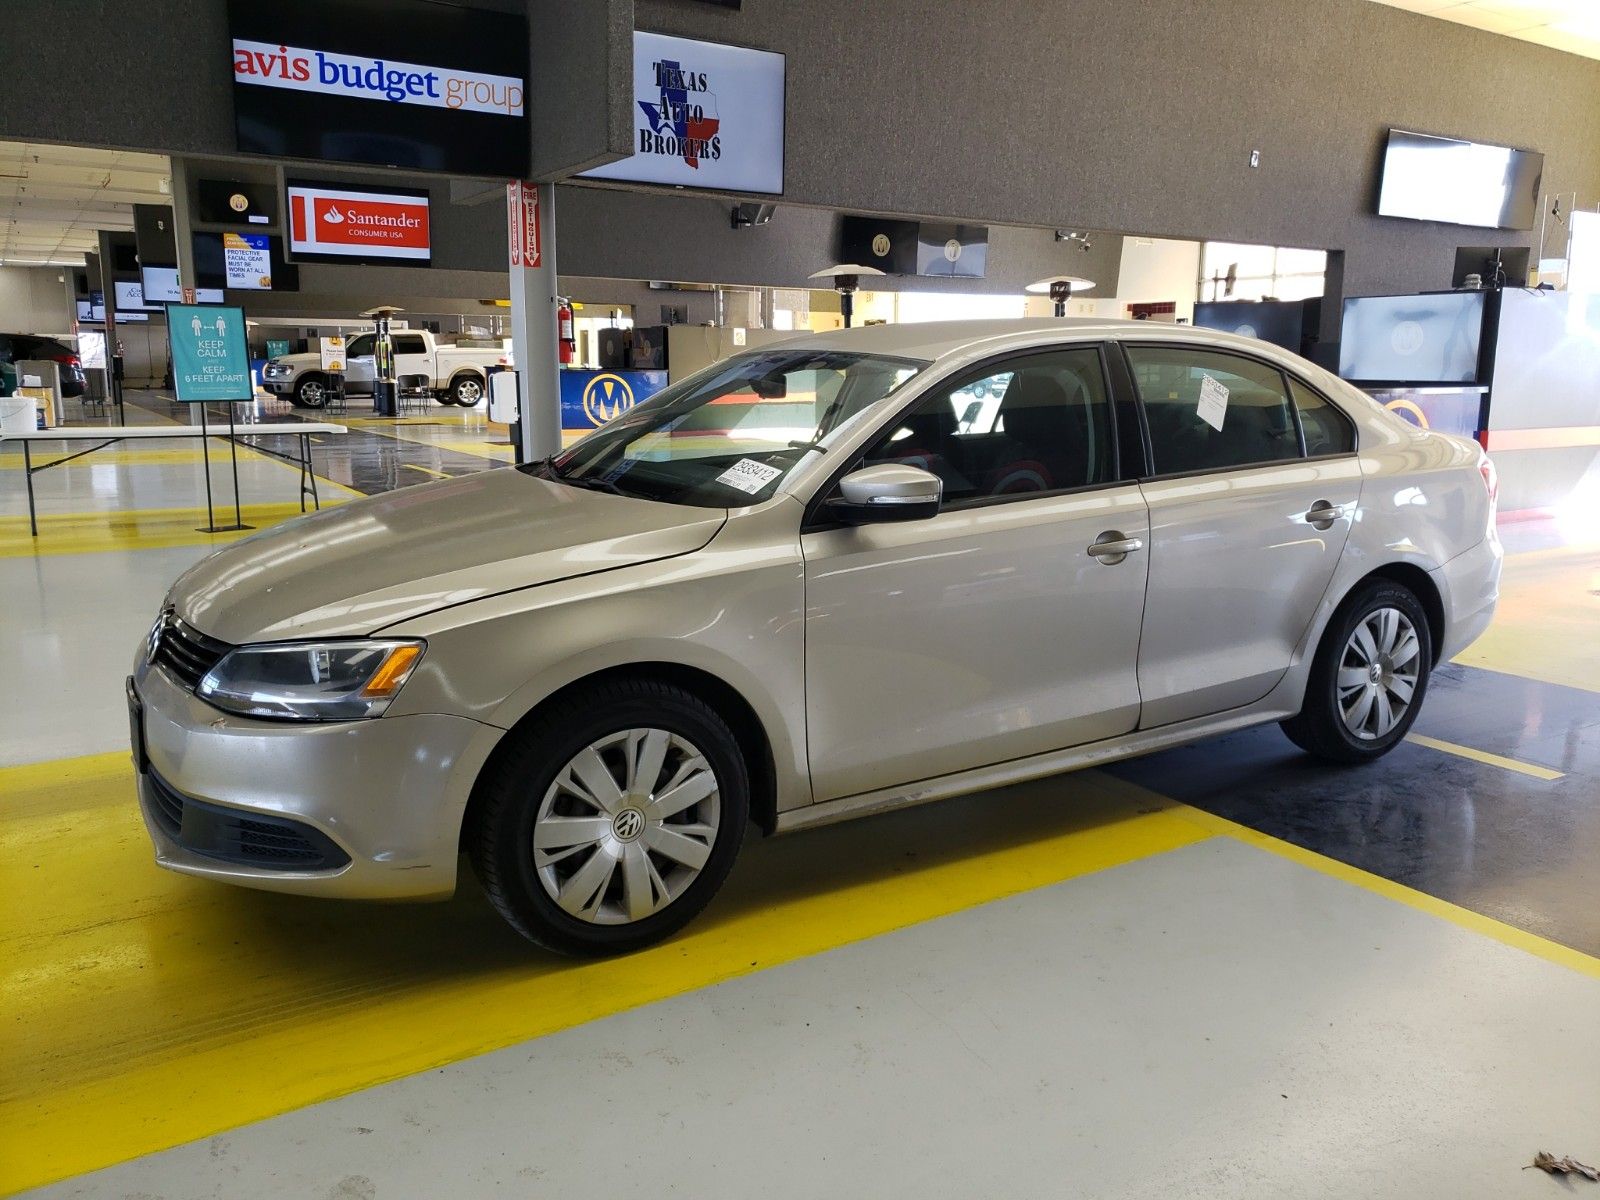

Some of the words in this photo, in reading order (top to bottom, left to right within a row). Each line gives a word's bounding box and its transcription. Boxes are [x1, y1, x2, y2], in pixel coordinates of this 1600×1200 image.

[233, 45, 310, 81] avis
[315, 52, 440, 102] budget
[446, 78, 523, 114] group
[652, 61, 707, 93] TEXAS
[658, 95, 704, 124] AUTO
[523, 191, 537, 201] FIRE
[347, 209, 420, 228] Santander
[348, 228, 388, 238] CONSUMER
[389, 230, 404, 239] USA
[527, 202, 535, 261] EXTINGUISHER
[198, 340, 224, 349] KEEP
[197, 349, 227, 358] CALM
[202, 365, 225, 374] KEEP
[192, 374, 214, 382] FEET
[216, 374, 244, 382] APART
